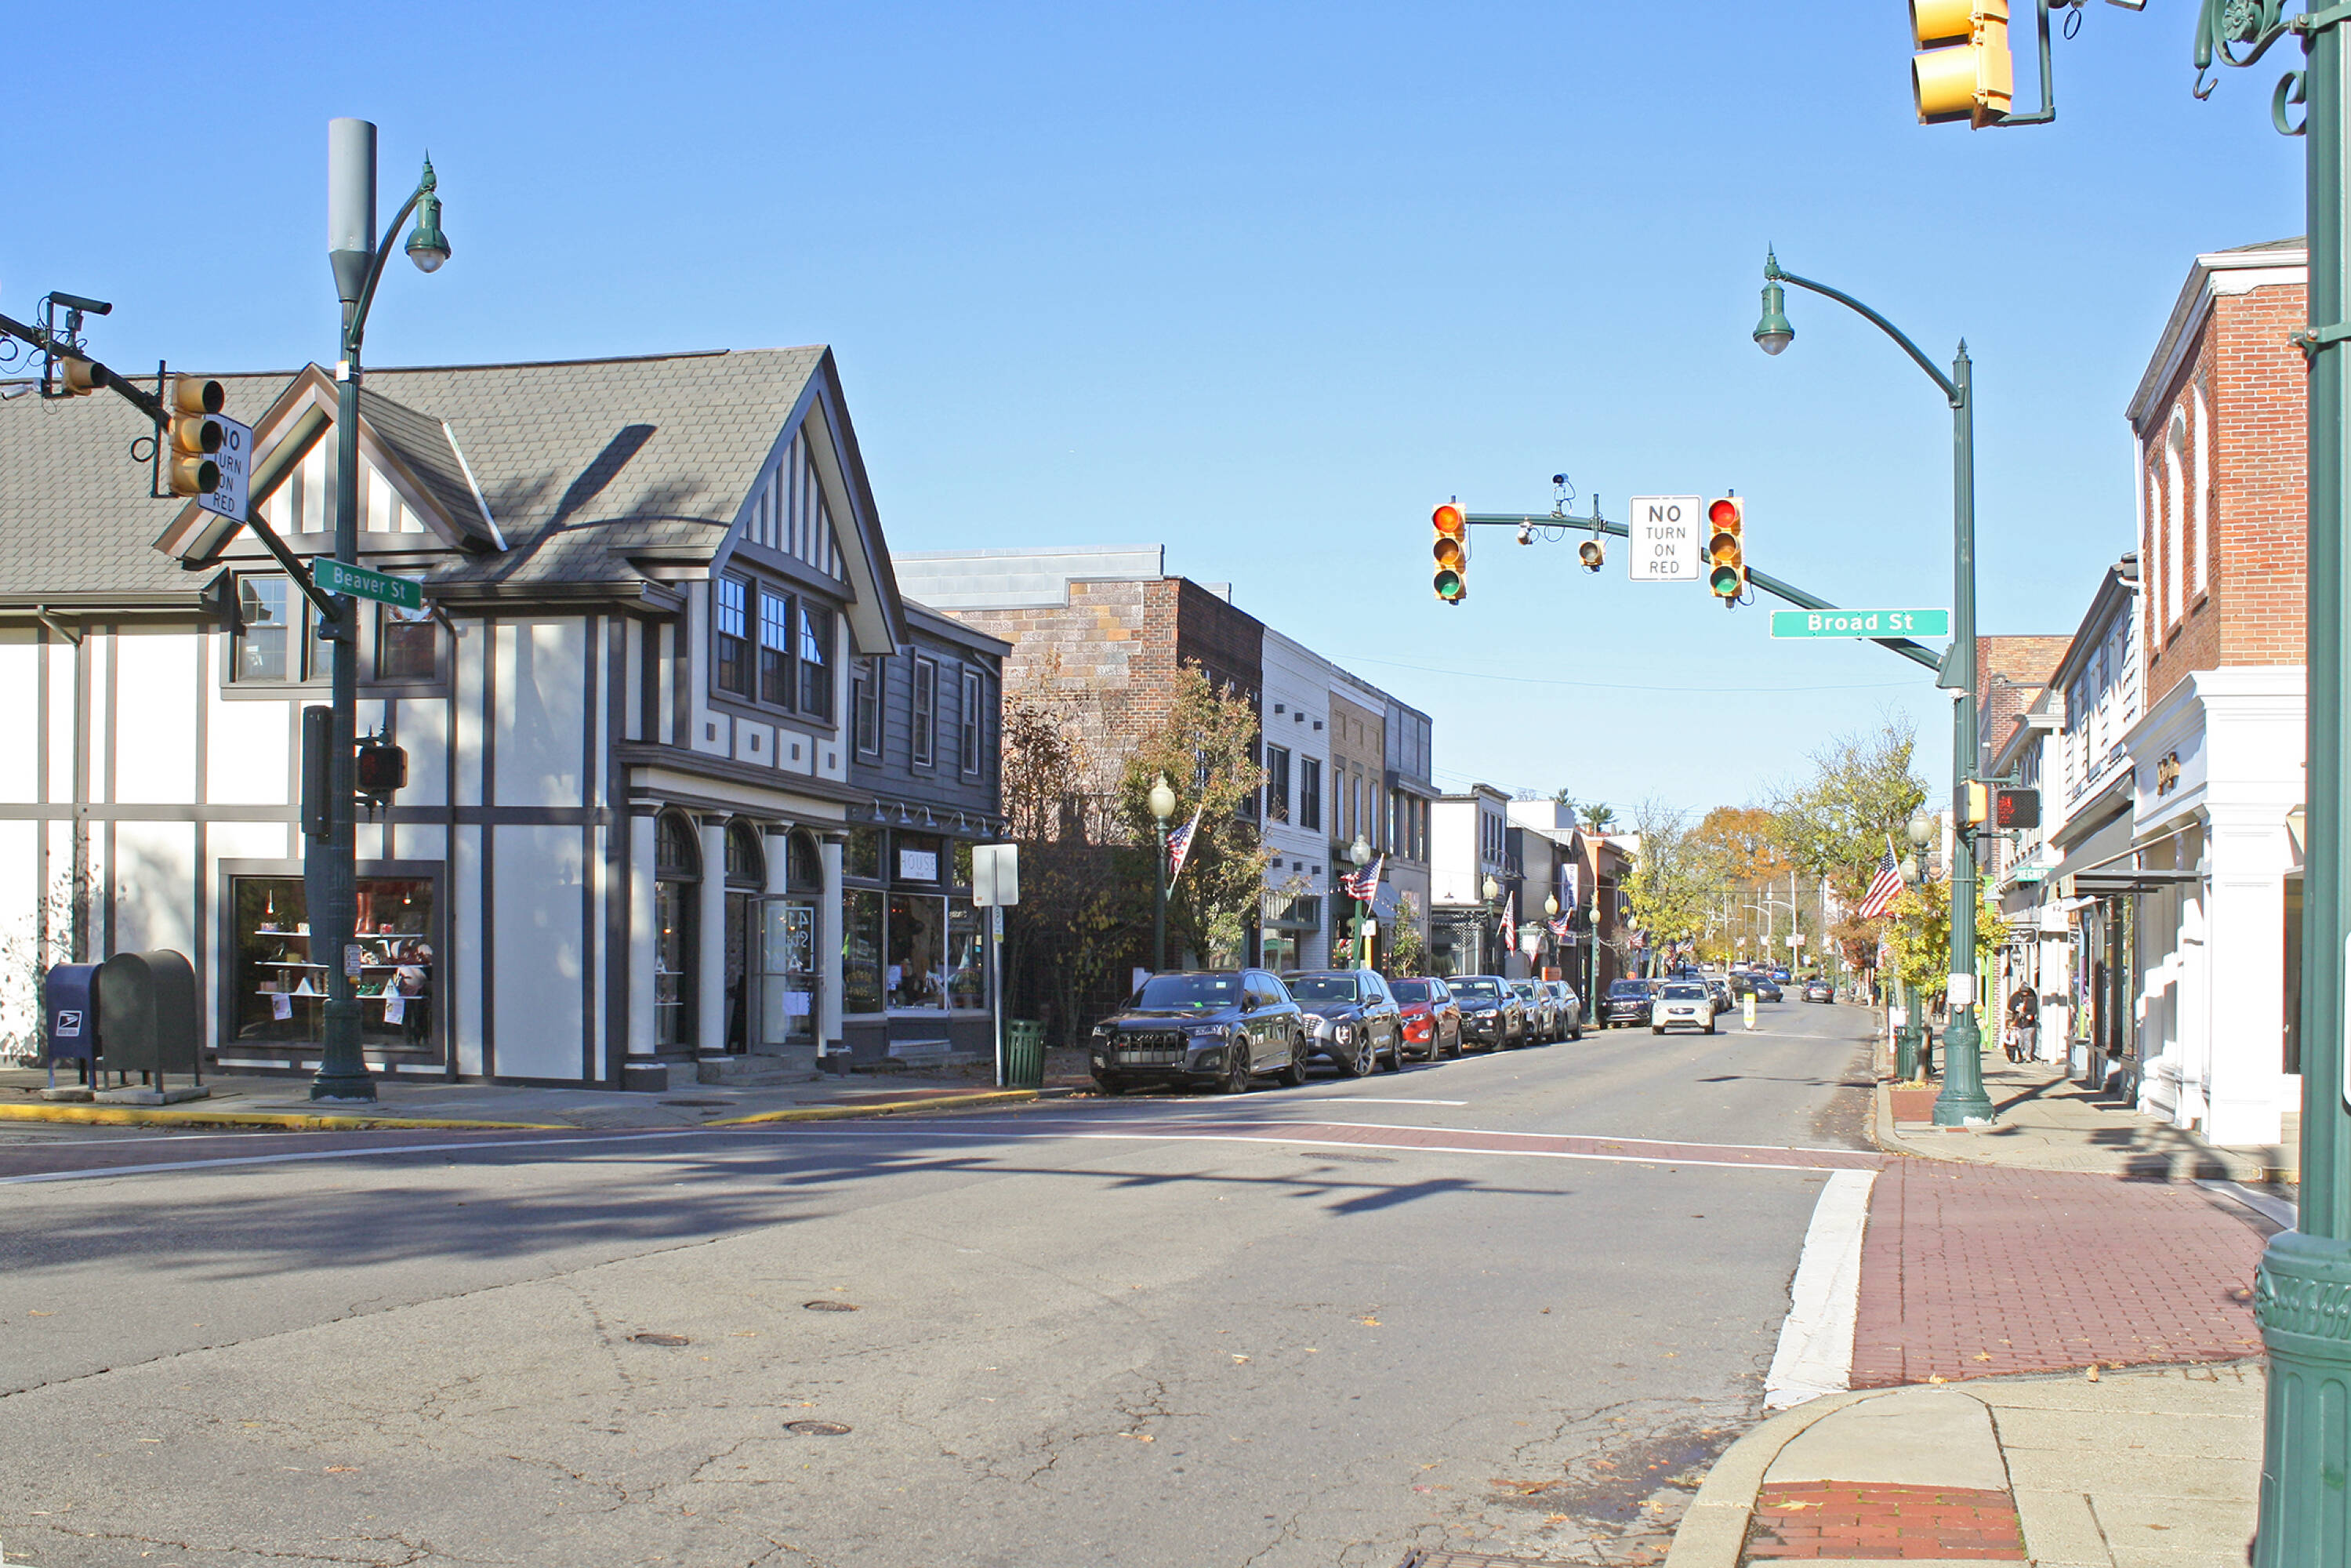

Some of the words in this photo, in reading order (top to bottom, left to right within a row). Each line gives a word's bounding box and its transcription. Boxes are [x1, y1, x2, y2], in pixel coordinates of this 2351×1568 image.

[212, 492, 235, 513] RED
[1649, 505, 1681, 522] NO
[1645, 527, 1685, 539] TURN
[1654, 543, 1674, 557] ON
[1649, 561, 1679, 573] RED
[333, 566, 386, 594] Beaver
[391, 581, 406, 600] St
[1808, 613, 1878, 631] Broad
[1888, 613, 1914, 630] St
